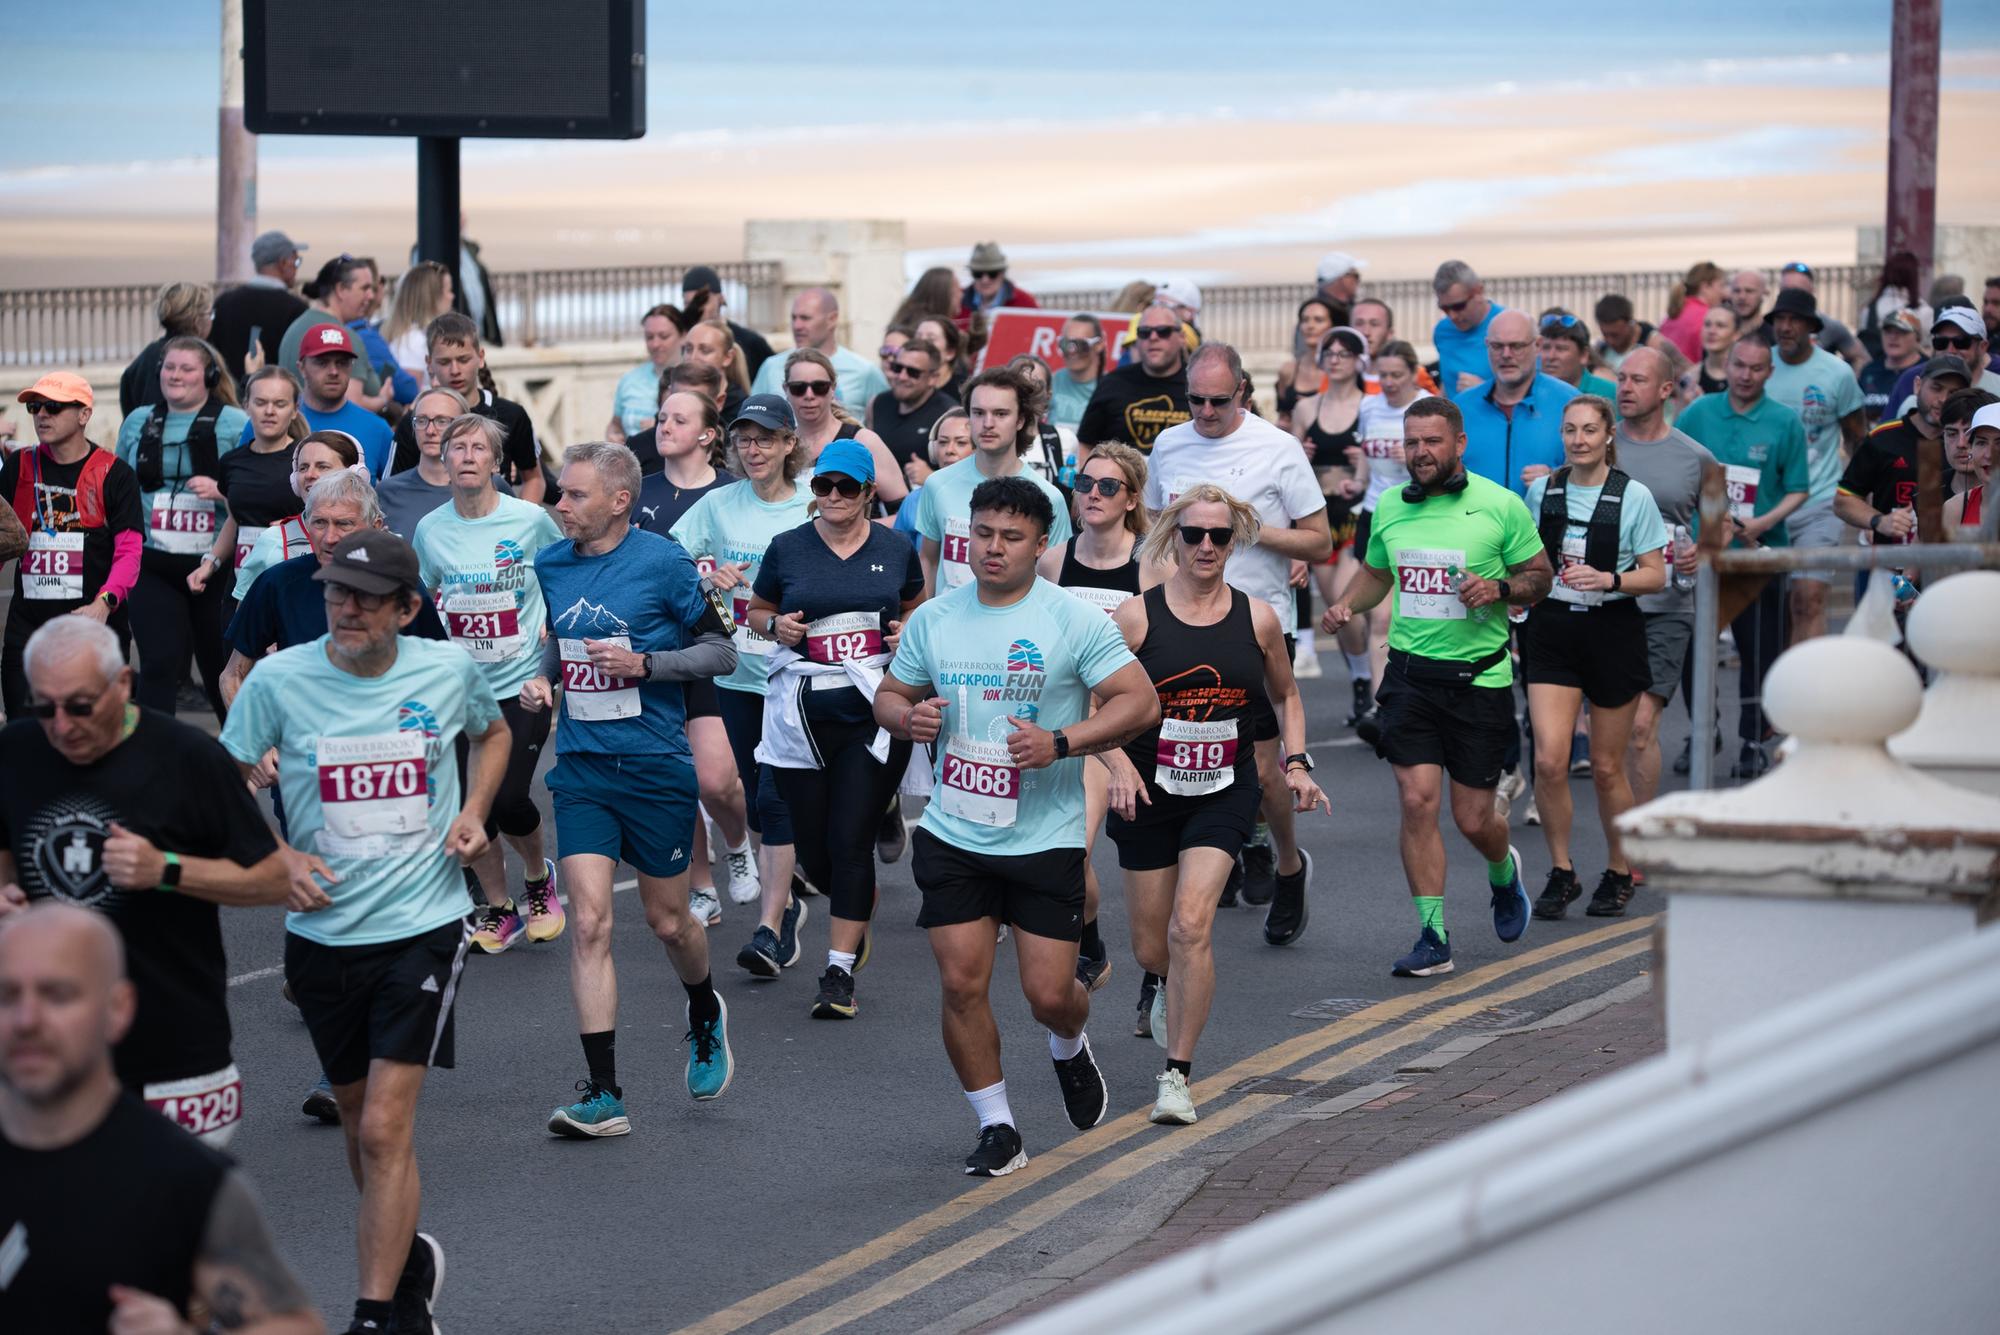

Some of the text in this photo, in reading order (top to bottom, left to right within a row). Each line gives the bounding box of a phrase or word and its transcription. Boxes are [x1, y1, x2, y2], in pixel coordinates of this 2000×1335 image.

[158, 510, 209, 532] 1418
[29, 551, 70, 575] 218
[723, 548, 764, 563] BLACKPO
[35, 576, 61, 587] JOHN
[496, 565, 526, 581] FUN
[474, 577, 525, 594] 10K RUN
[459, 613, 502, 638] 231
[474, 639, 494, 650] LYN
[822, 632, 869, 661] 192
[940, 659, 1005, 671] BEAVERBROOKS
[940, 672, 1047, 689] BLACKPOOL FUN
[982, 687, 1042, 702] 10K RUN
[1166, 721, 1234, 735] BEAVERBROOKS
[324, 738, 418, 755] BEAVERBROOKS
[952, 738, 1010, 758] BEAVERBROOK
[1173, 743, 1224, 769] 819
[328, 761, 419, 800] 1870
[947, 758, 1011, 797] 2068
[1170, 769, 1222, 783] MARTINA
